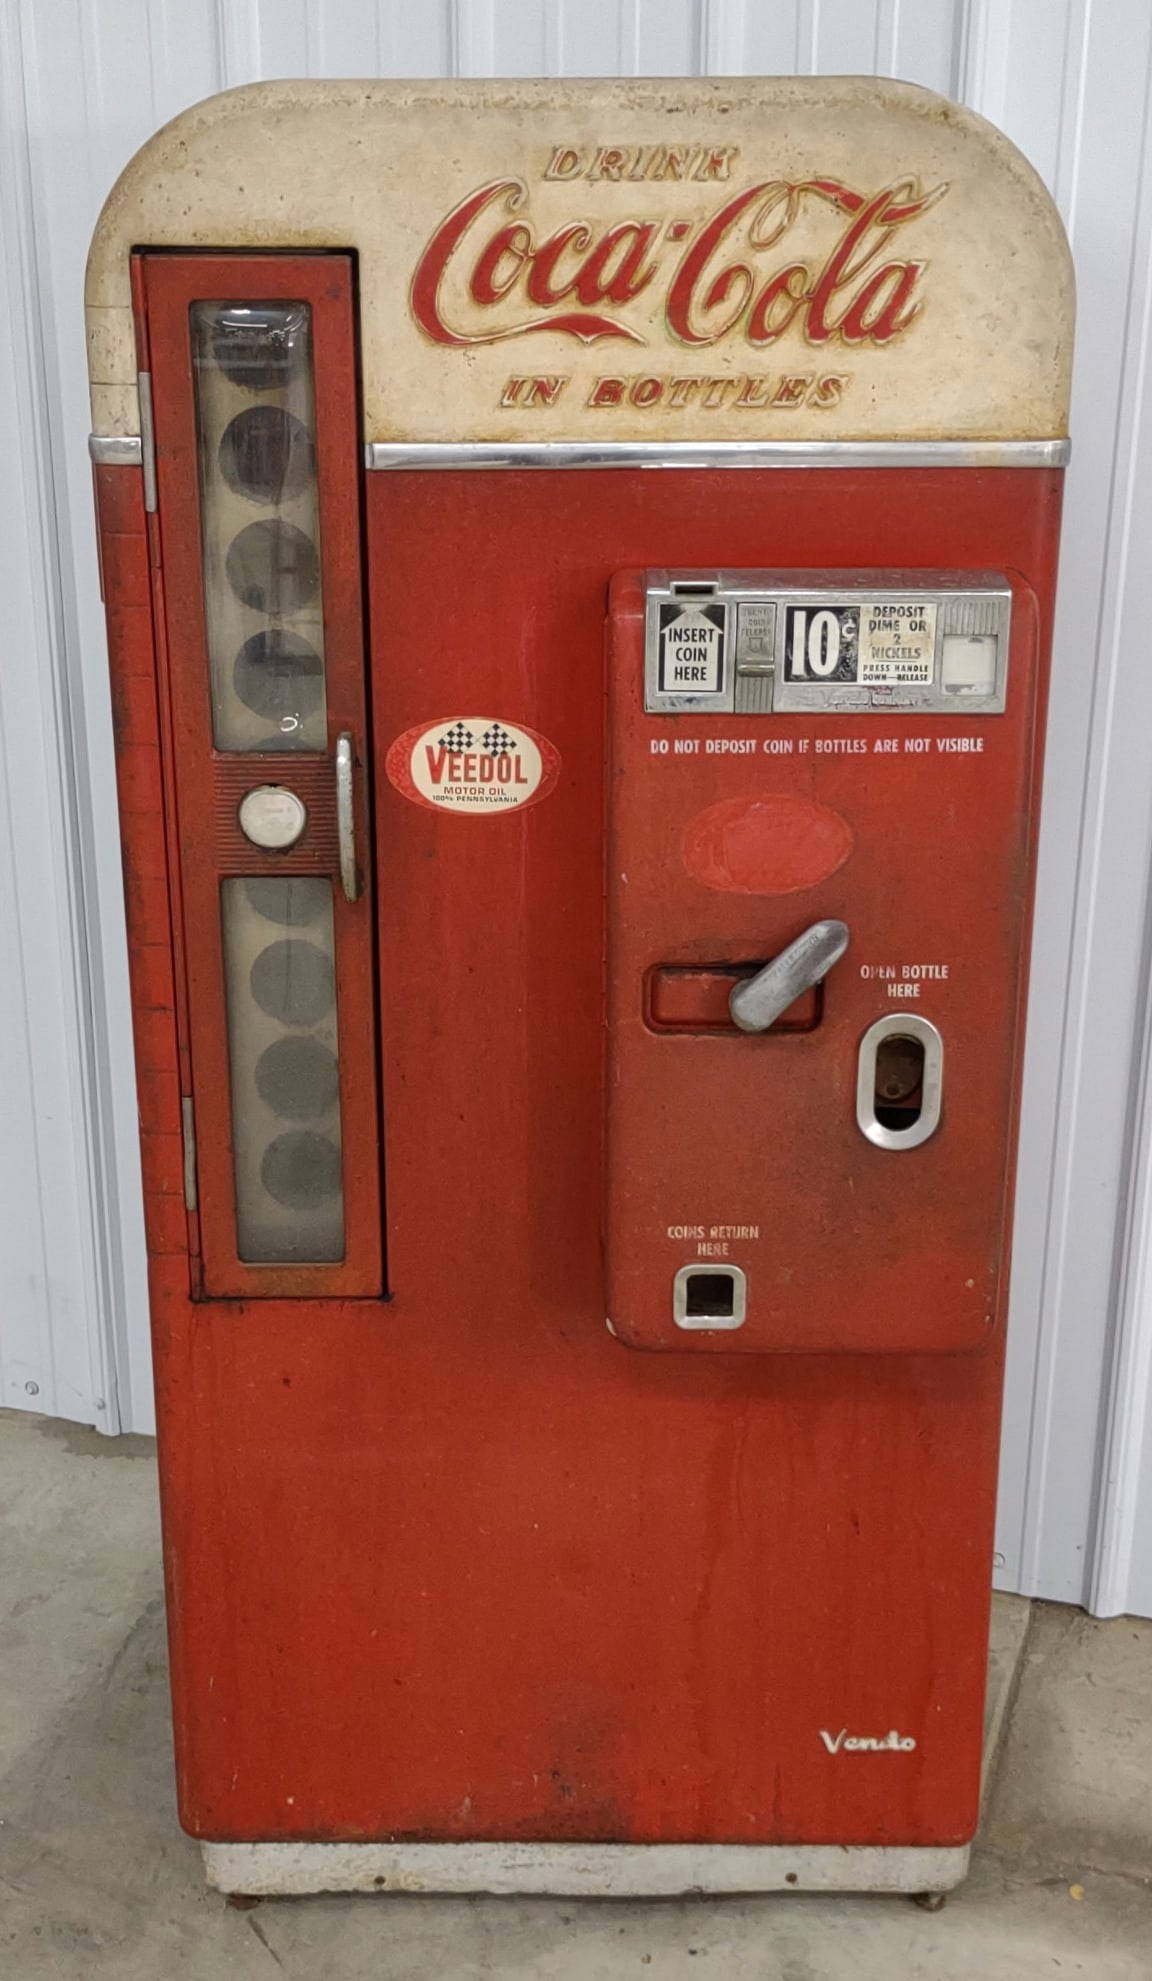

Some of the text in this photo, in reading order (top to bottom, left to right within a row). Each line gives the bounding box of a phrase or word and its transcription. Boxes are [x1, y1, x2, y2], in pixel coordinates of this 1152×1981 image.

[542, 145, 740, 182] DRINK
[408, 175, 952, 347] Coca-Cola
[501, 375, 850, 409] IN BOTTLES
[873, 606, 926, 618] DEPOSIT
[868, 620, 927, 632] DIME OR
[668, 628, 714, 643] INSERT
[893, 634, 902, 645] 2
[675, 647, 707, 662] COIN
[871, 647, 922, 660] NICKELS
[674, 666, 708, 681] HERE
[863, 664, 929, 673] PRESS HANDLE
[650, 737, 984, 754] DO NOT DEPOSIT COIN IF BOTTLES ARE NOT VISIBLE
[425, 745, 528, 784] VEEDOL
[444, 786, 507, 796] MOTOR OIL
[456, 795, 518, 803] PENNSYLVANIA
[902, 965, 949, 979] BOTTLE
[887, 983, 921, 997] HERE
[667, 1225, 760, 1239] COINS RETURN
[697, 1242, 729, 1256] HERE
[819, 1728, 917, 1755] Vendo
